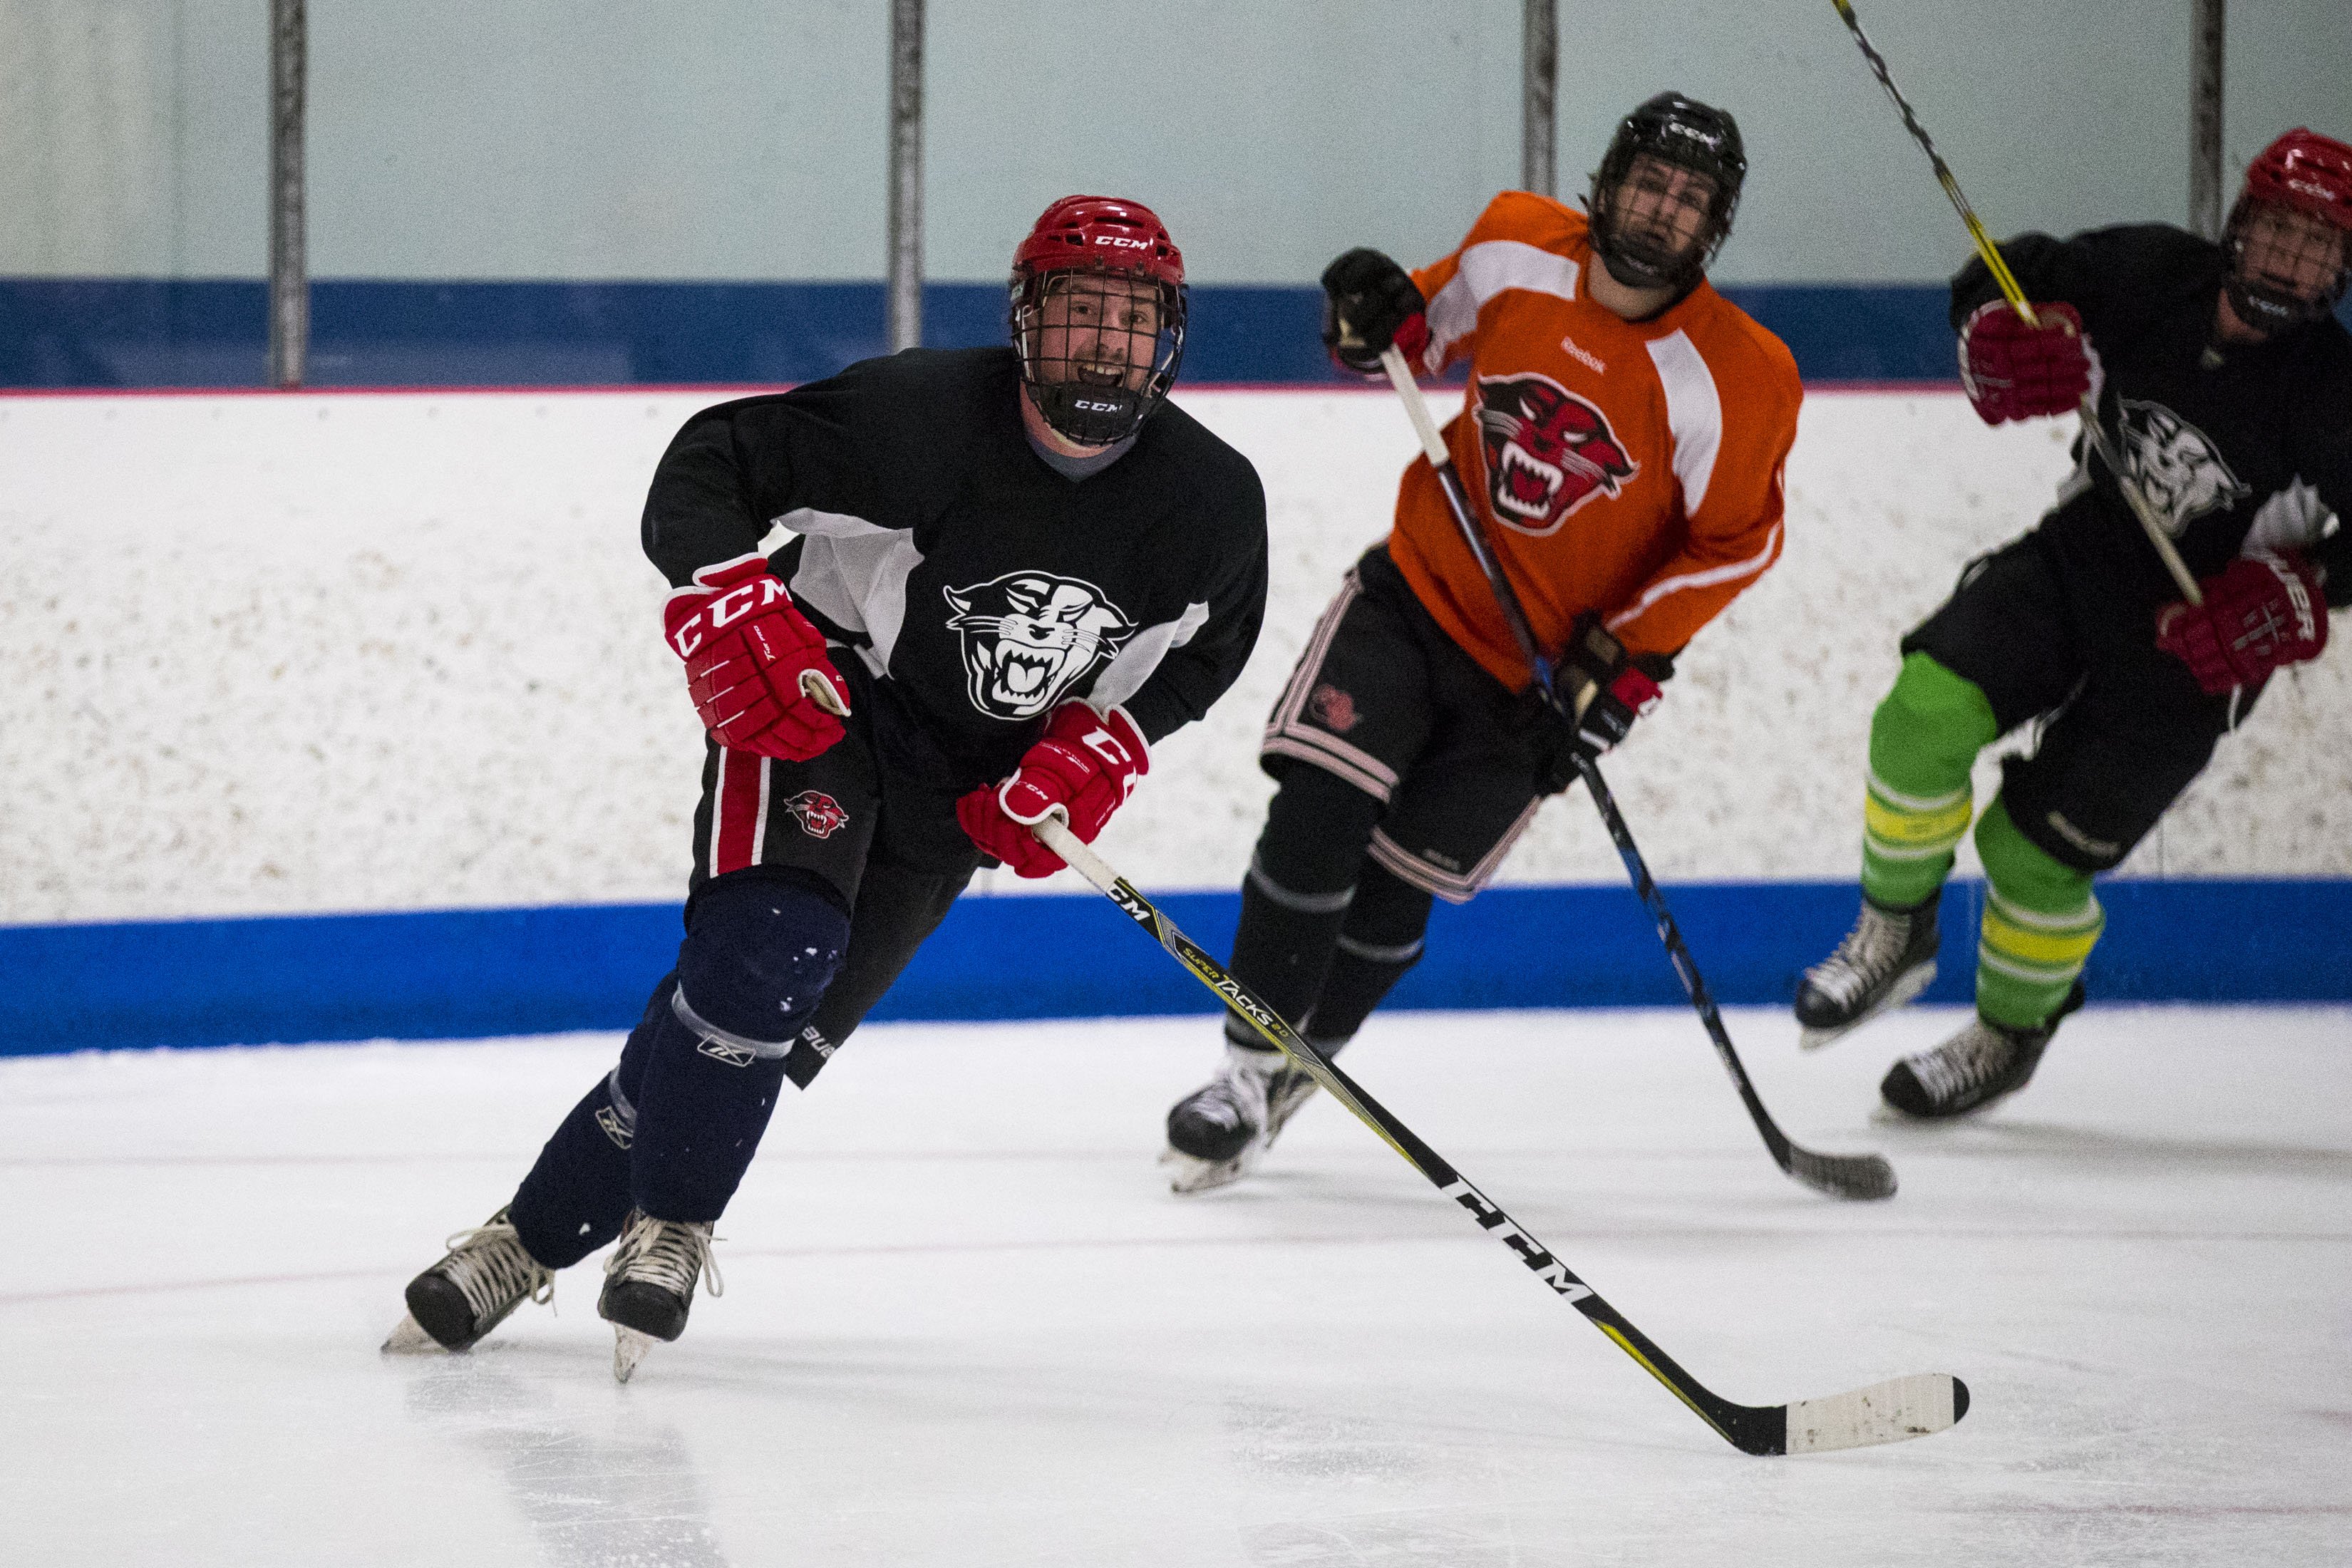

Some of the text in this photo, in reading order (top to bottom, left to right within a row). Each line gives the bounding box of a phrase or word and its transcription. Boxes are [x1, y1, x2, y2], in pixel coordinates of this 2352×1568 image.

[1095, 236, 1148, 249] CCM
[1561, 336, 1608, 376] Reebok
[1075, 400, 1123, 413] CCM
[674, 579, 793, 657] CCM
[753, 626, 766, 641] PRO
[1107, 886, 1150, 922] CM
[1183, 947, 1219, 979] SUPER
[1216, 974, 1274, 1026] TACKS
[1440, 1174, 1594, 1304] CCM
